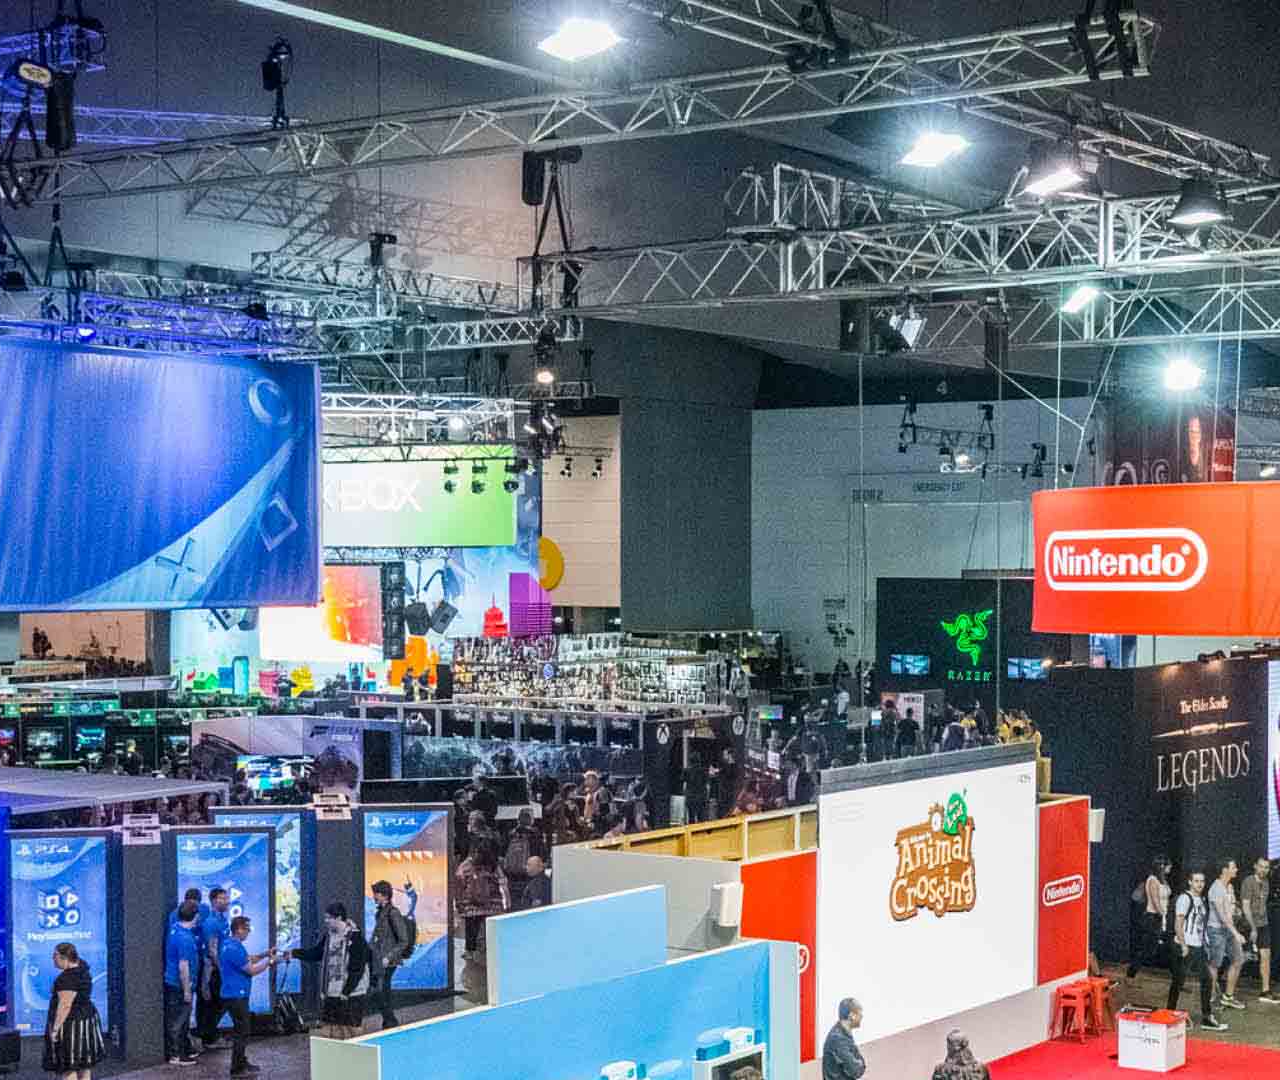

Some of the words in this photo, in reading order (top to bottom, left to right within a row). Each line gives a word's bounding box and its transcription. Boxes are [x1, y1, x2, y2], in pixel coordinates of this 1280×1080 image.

[1052, 543, 1187, 577] Nintendo
[1156, 741, 1250, 793] LEGENDS
[899, 825, 971, 877] Animal
[892, 866, 974, 915] Crossing
[1046, 879, 1082, 902] Nintendo
